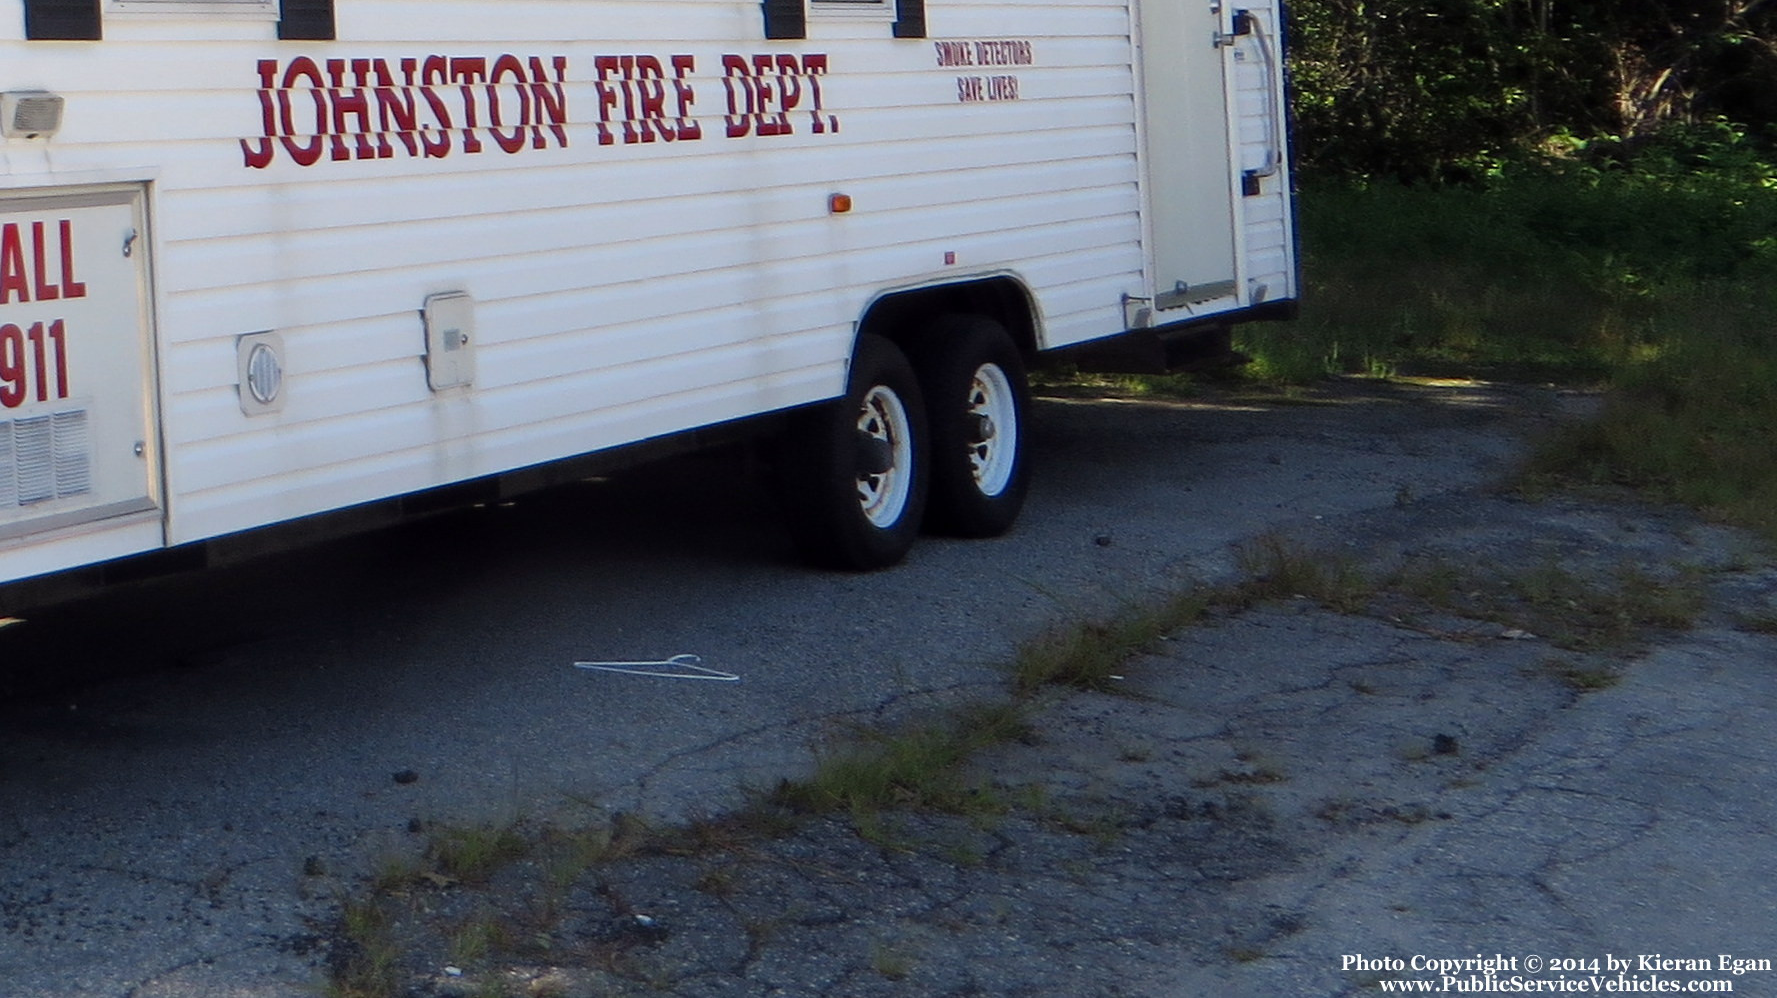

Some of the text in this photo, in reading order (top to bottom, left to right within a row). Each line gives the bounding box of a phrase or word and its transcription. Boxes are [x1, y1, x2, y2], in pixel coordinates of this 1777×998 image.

[934, 40, 1033, 67] SMOKE DETECTORS
[956, 75, 1019, 102] SAVE LIVES!
[239, 54, 839, 169] JOHNSTON FIRE DEPT.
